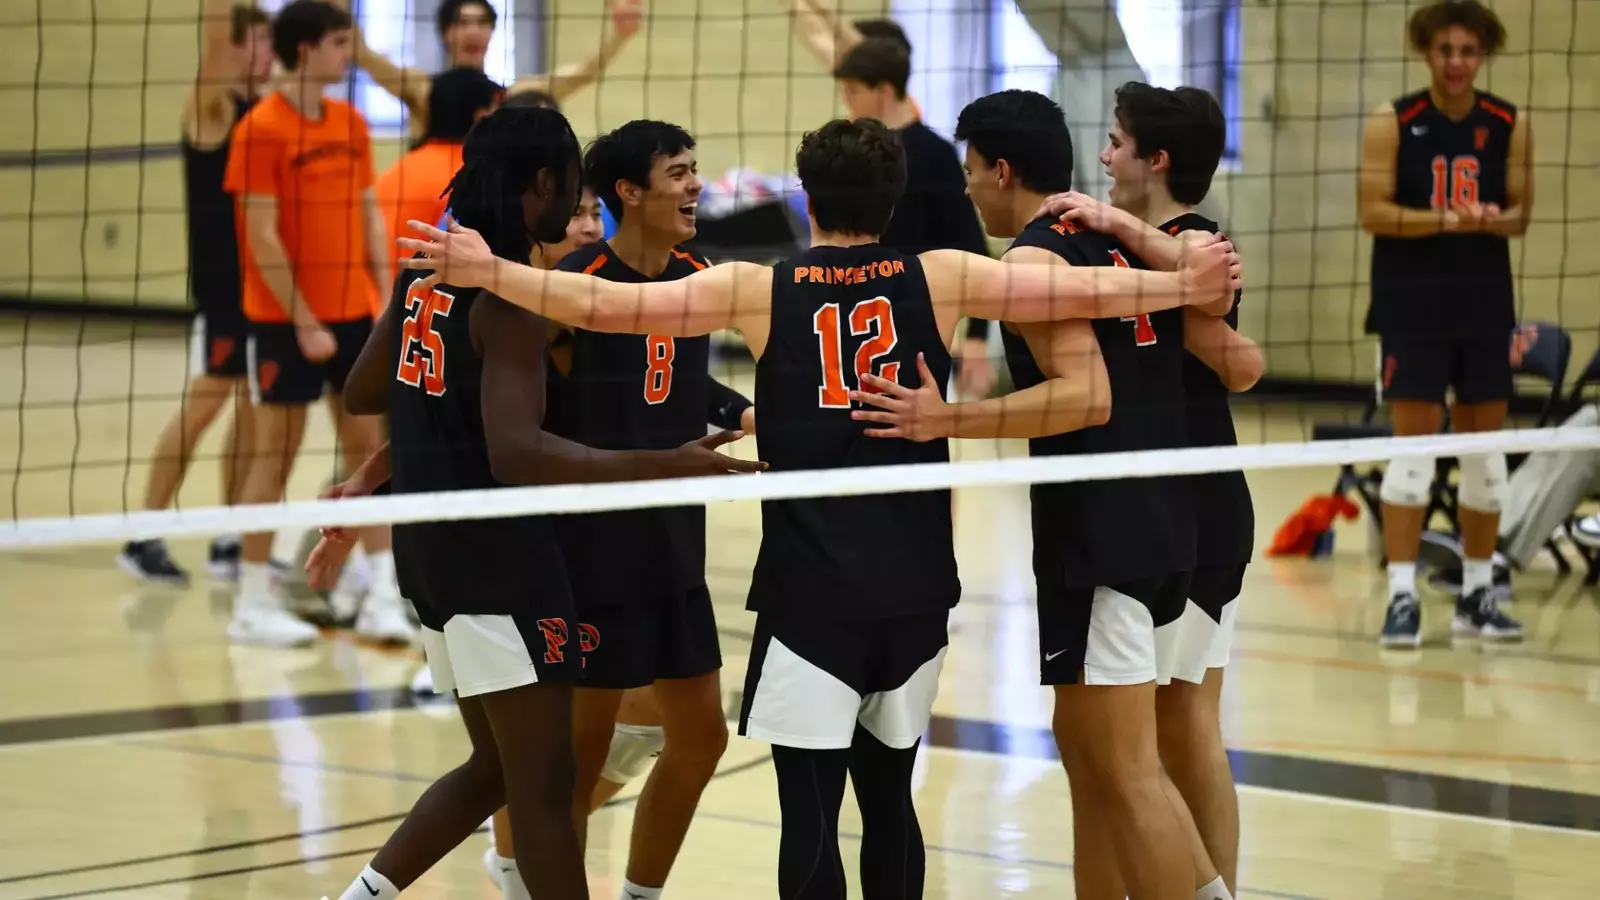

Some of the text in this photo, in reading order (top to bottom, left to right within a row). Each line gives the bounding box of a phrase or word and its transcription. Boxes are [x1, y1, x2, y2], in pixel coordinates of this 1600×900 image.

[1431, 155, 1480, 207] 16
[794, 260, 905, 285] PRINCETON
[397, 277, 455, 397] 25
[813, 295, 900, 409] 12
[644, 334, 675, 405] 8
[536, 617, 568, 664] P
